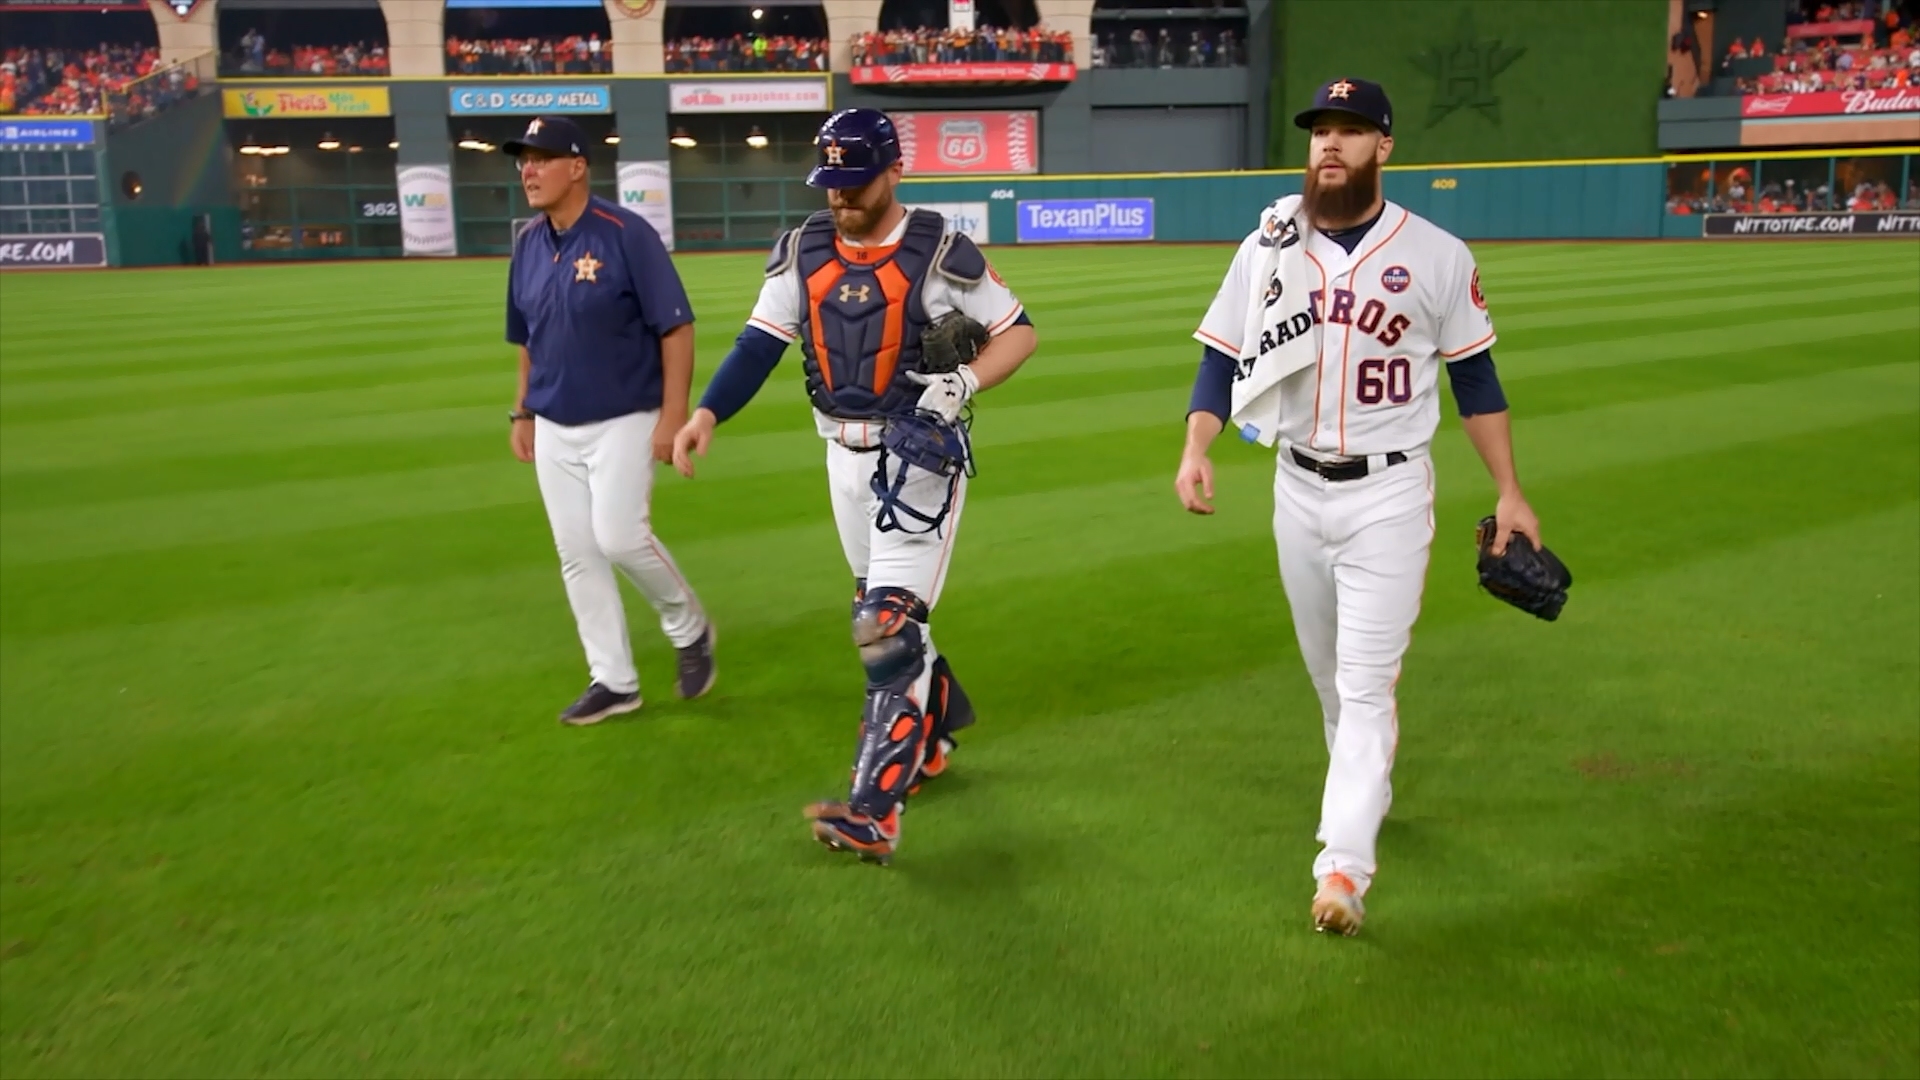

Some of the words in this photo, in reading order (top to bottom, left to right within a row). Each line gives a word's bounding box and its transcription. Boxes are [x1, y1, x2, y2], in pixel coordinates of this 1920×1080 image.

[460, 93, 473, 108] C
[475, 94, 487, 107] &
[490, 93, 504, 108] D
[509, 93, 553, 107] SCRAP
[557, 93, 600, 106] METAL
[1841, 89, 1920, 113] Budw
[947, 138, 976, 156] 66
[991, 189, 1014, 199] 404
[363, 203, 398, 217] 362
[1027, 203, 1145, 228] TexanPlus
[1734, 215, 1855, 233] NITTOTIRE.COM
[1357, 358, 1412, 404] 60
